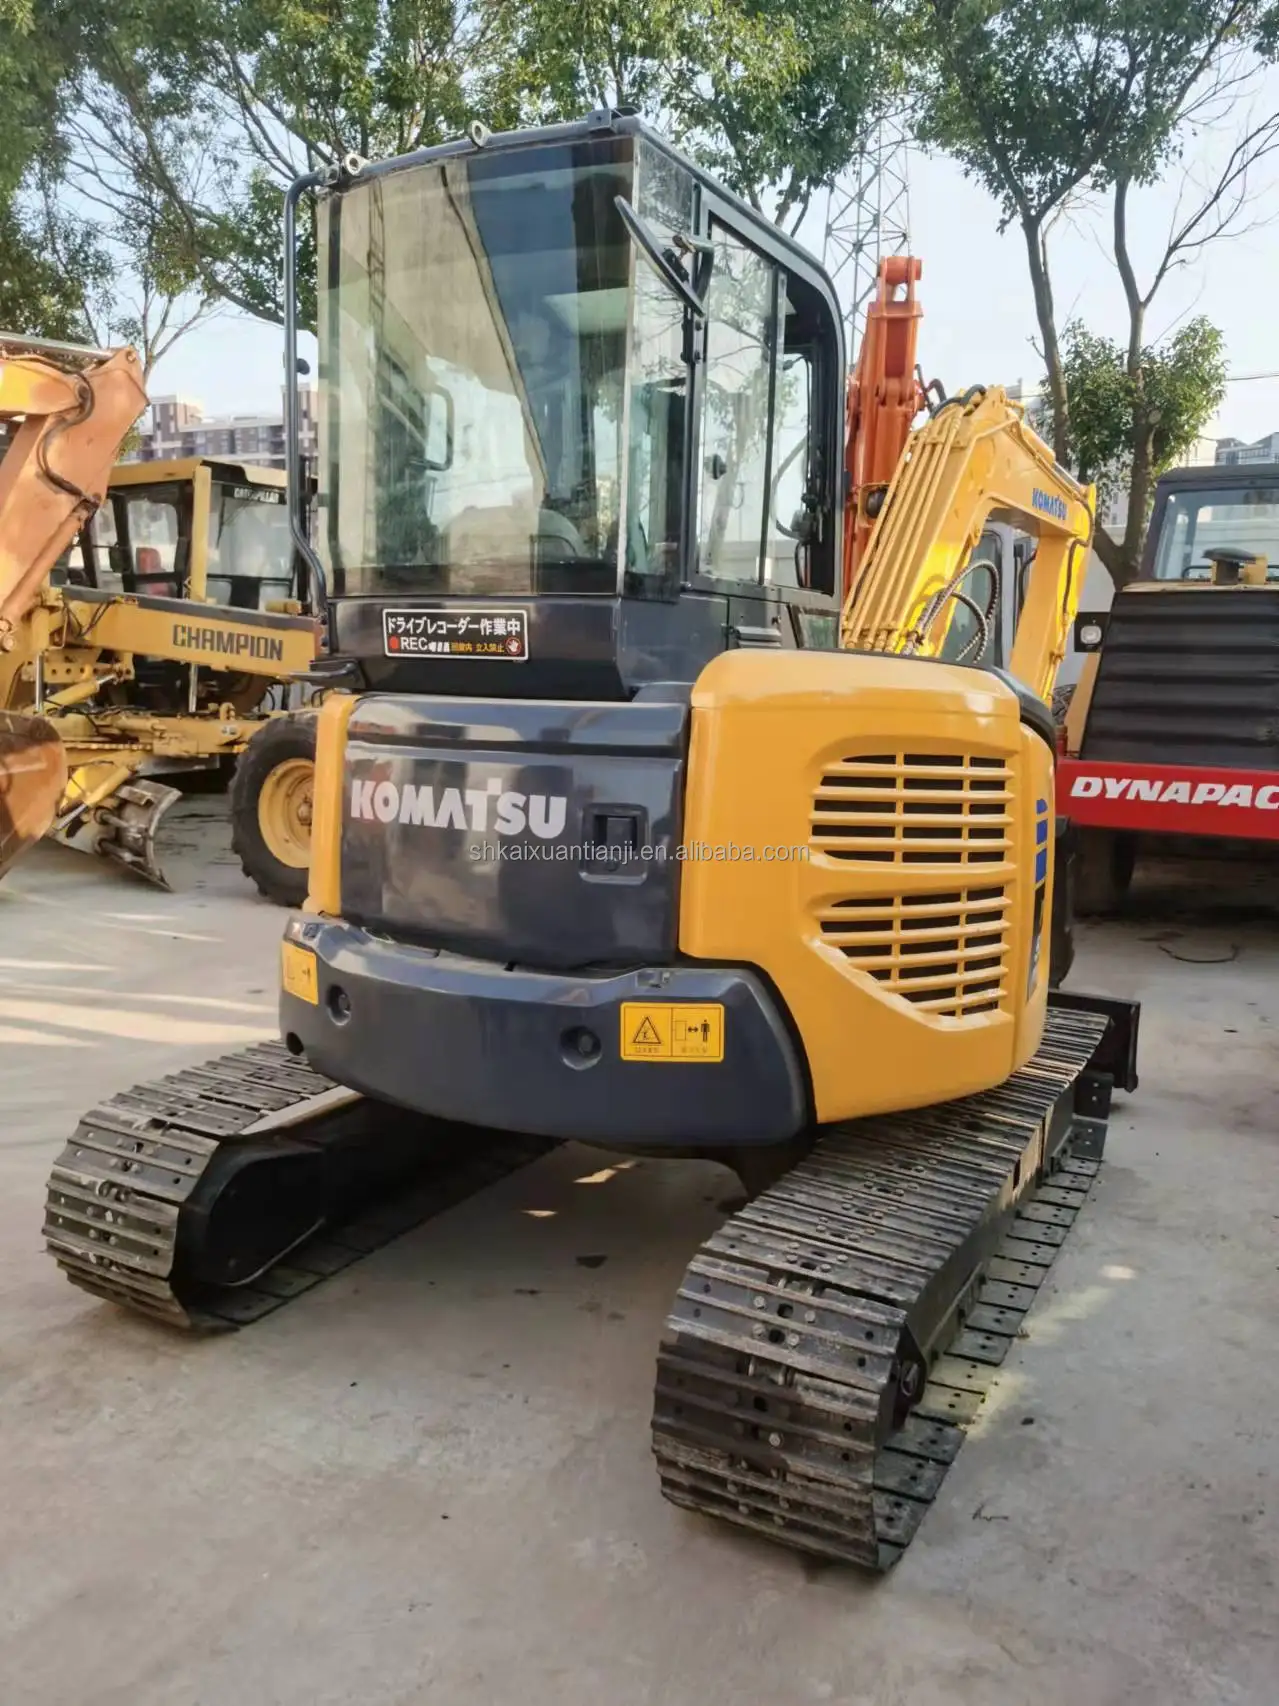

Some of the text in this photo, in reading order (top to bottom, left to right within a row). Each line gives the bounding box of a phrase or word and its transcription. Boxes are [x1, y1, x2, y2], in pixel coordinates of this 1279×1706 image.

[1032, 488, 1067, 520] KOMATSU
[173, 624, 284, 661] CHAMPION
[387, 616, 521, 636] ドライブレコーダー作業中
[400, 637, 428, 651] REC
[351, 778, 568, 839] KOMATSU
[1070, 776, 1279, 810] DYNAPAC
